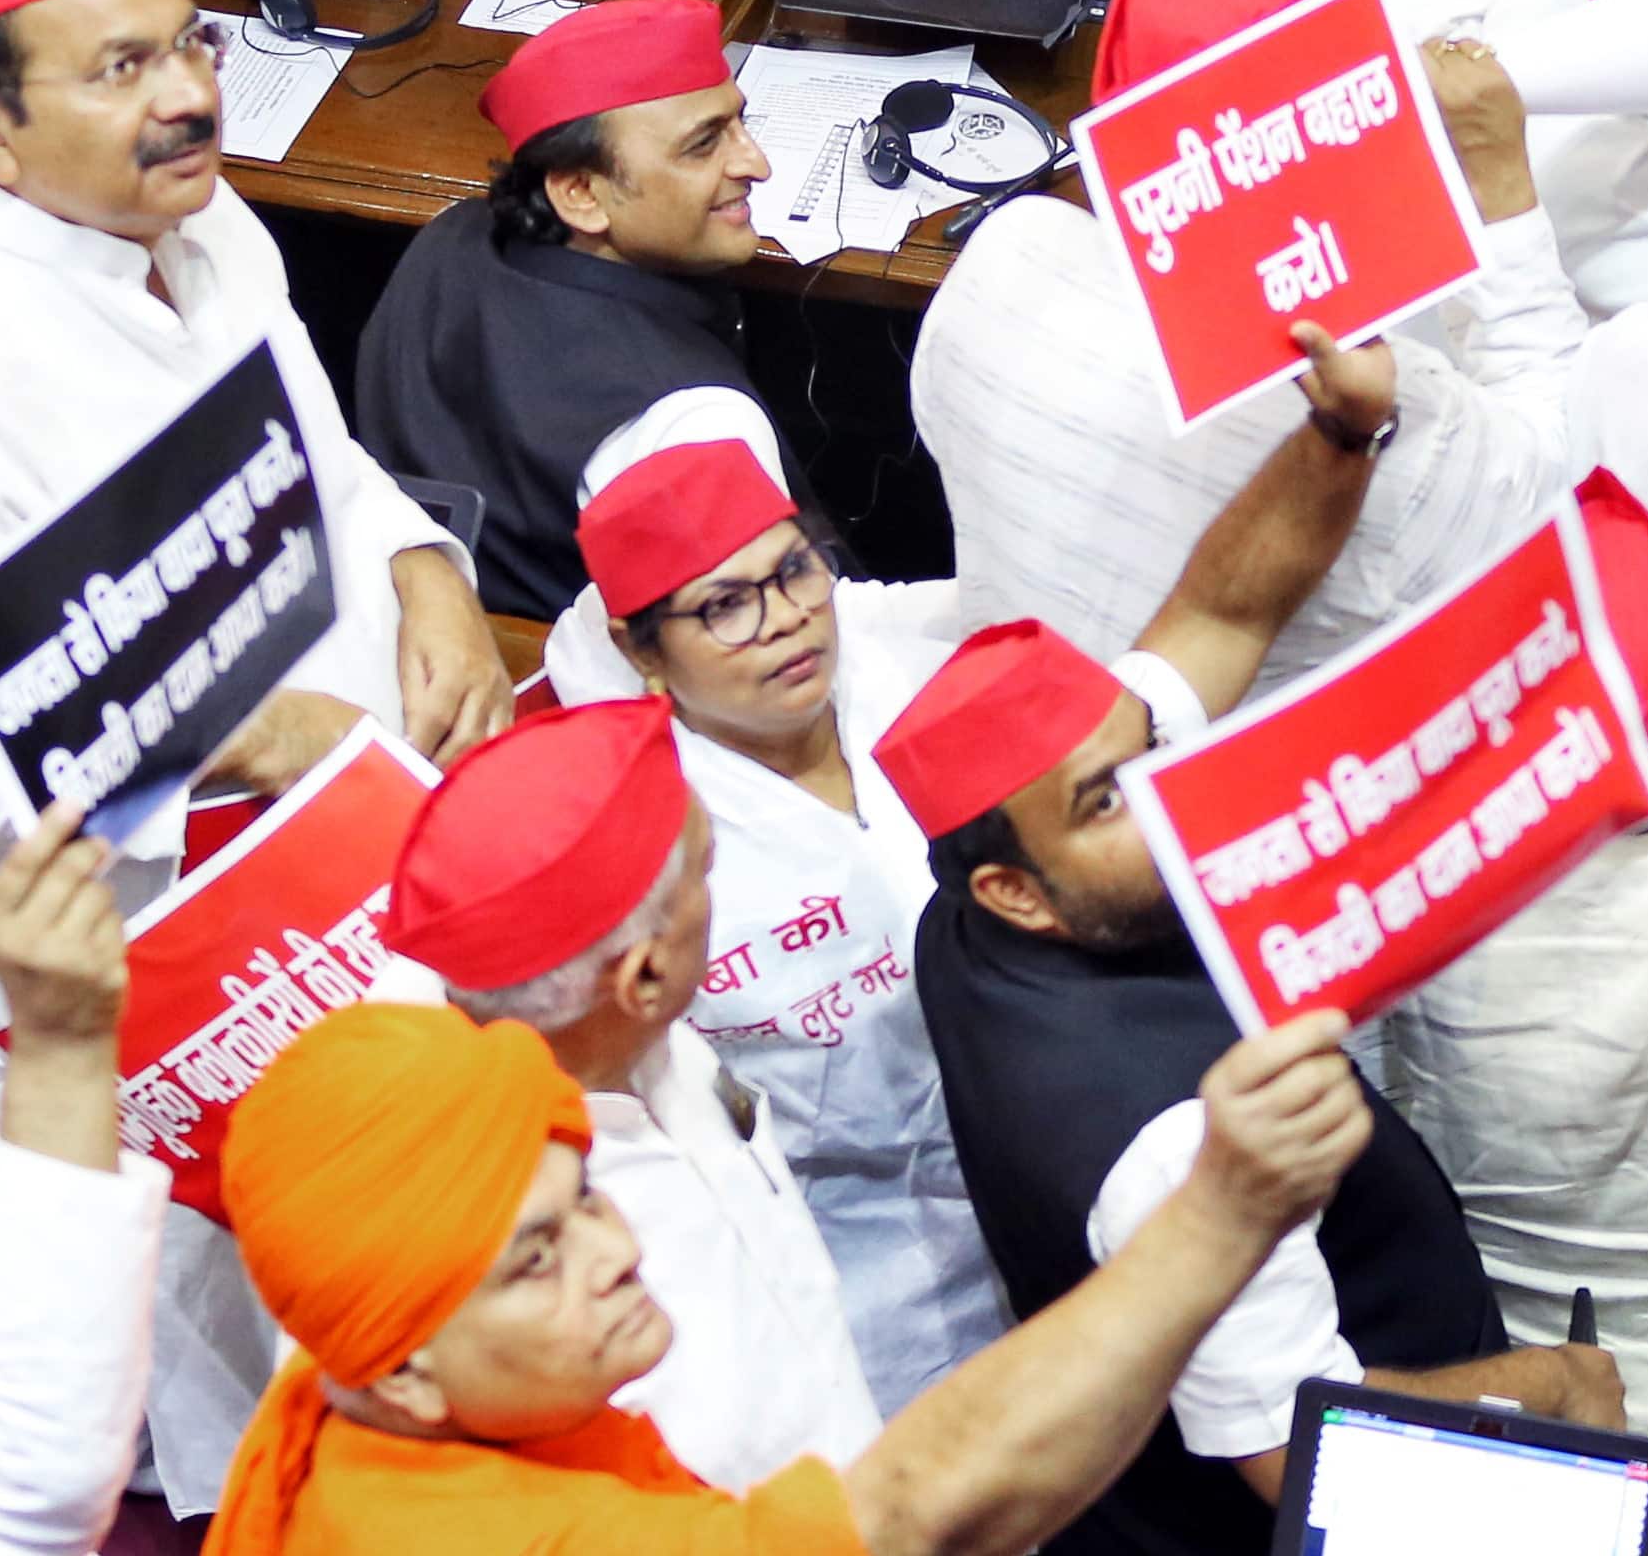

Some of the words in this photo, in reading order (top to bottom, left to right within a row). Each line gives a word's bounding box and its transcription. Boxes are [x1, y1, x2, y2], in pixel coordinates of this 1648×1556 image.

[1119, 127, 1223, 274] पुरानी
[1296, 54, 1399, 146] बहाल
[1255, 213, 1350, 313] करो।
[282, 929, 358, 1009] की
